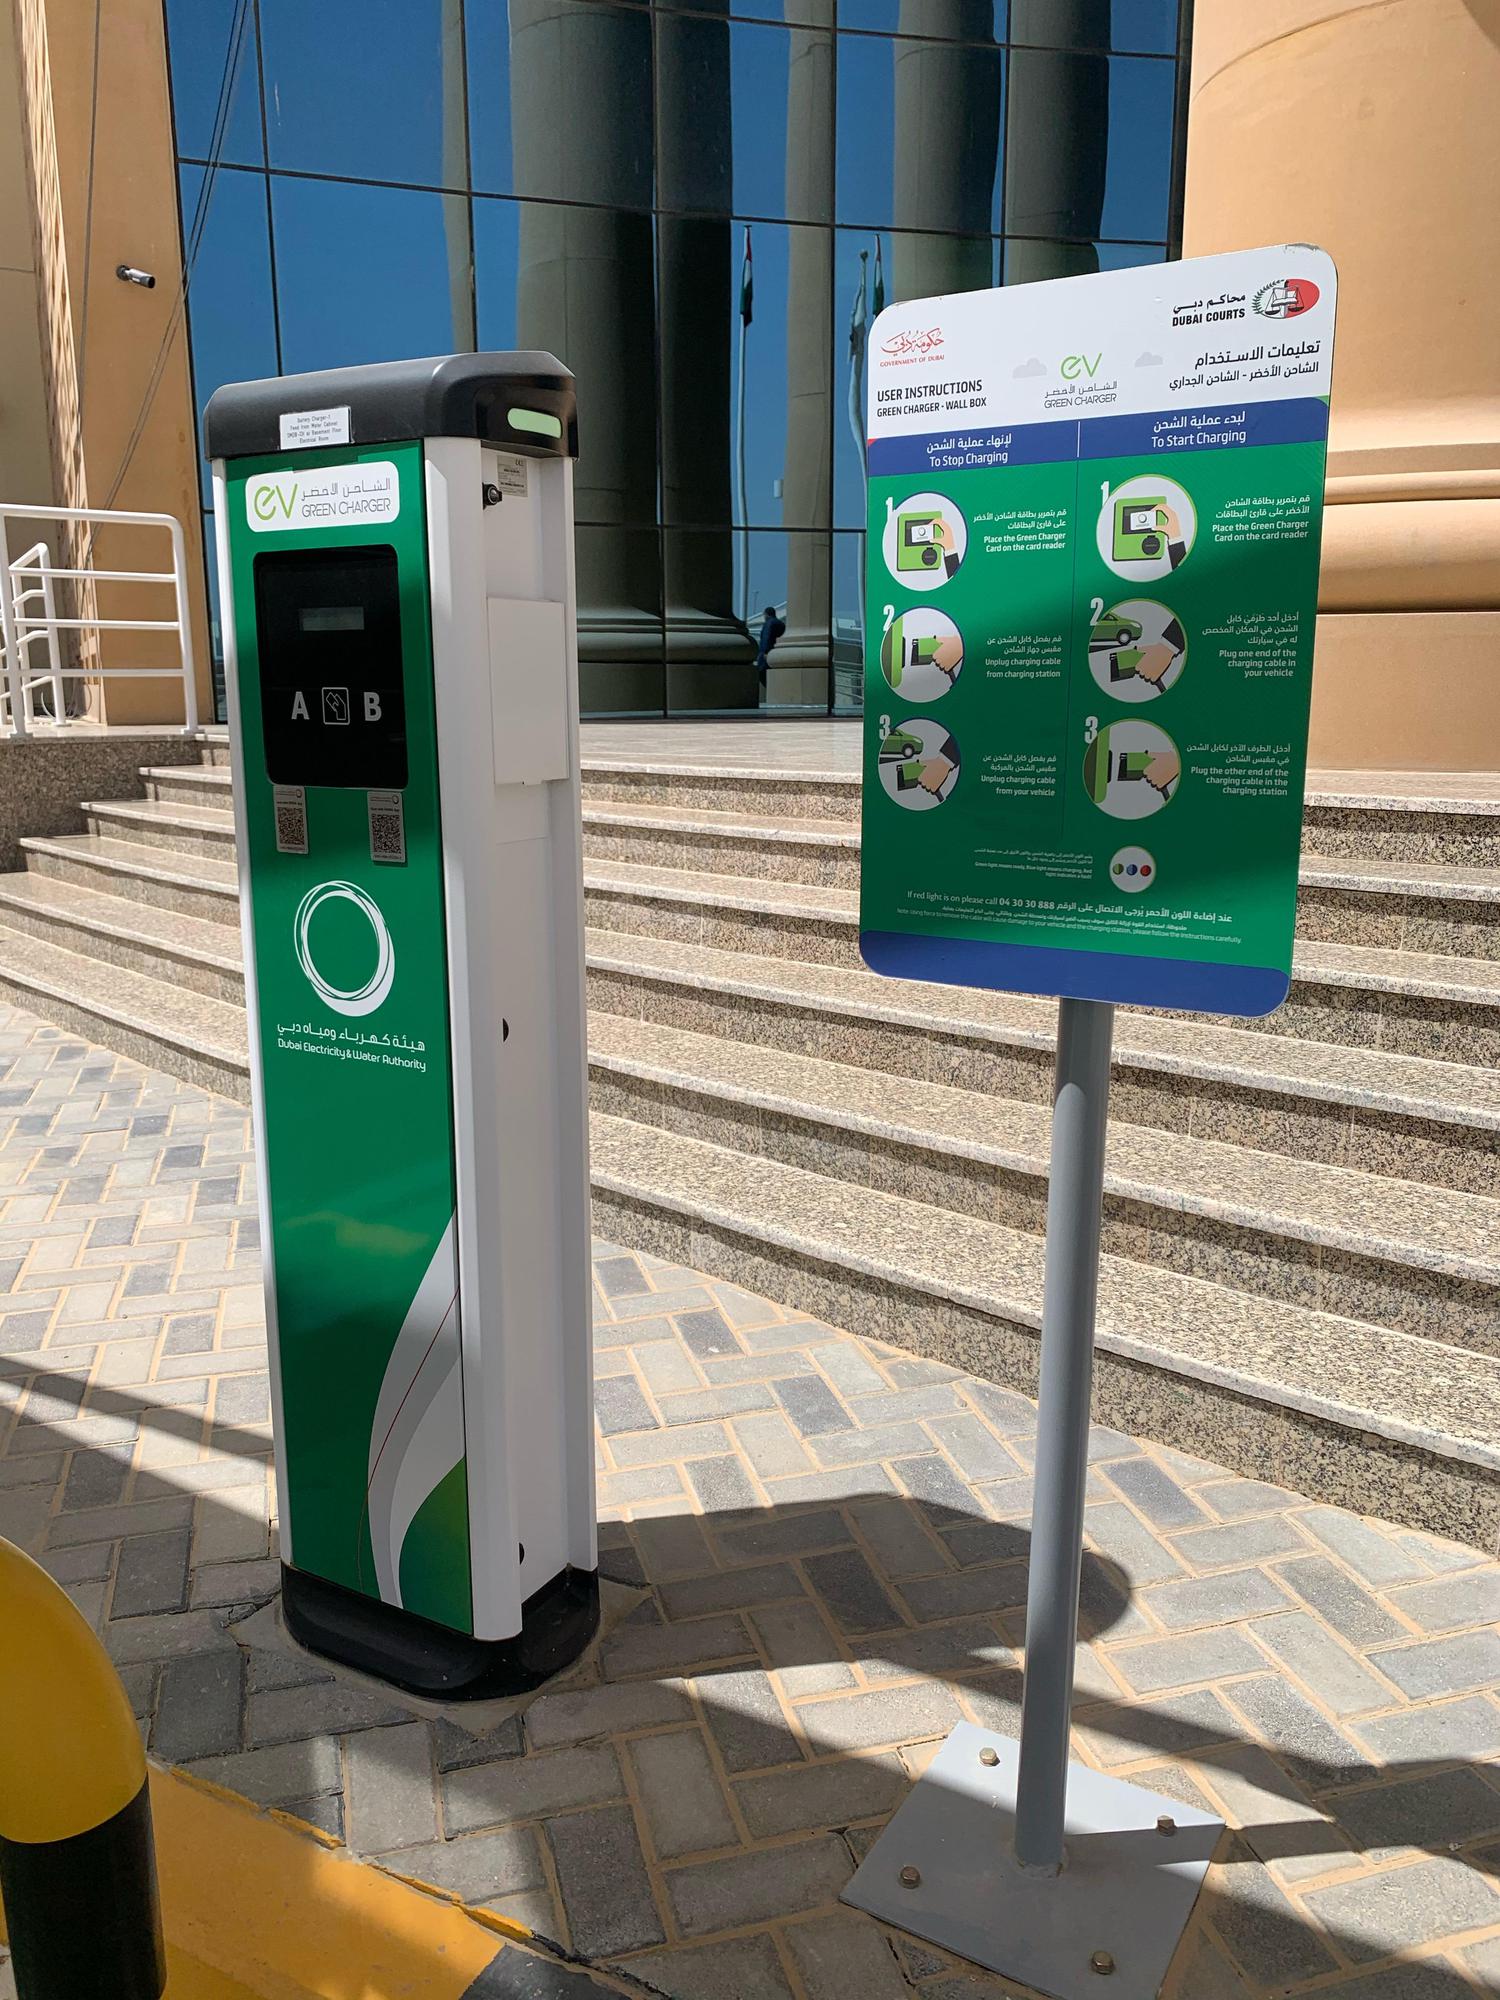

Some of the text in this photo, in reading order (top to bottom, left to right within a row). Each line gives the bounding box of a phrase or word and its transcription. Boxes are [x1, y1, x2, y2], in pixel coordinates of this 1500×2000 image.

[1173, 294, 1245, 314] محاكم دبي
[1173, 309, 1245, 327] DUBAI COURTS
[1268, 340, 1320, 359] تعليمات
[880, 358, 917, 367] GOVERNMENT
[1284, 362, 1319, 378] الشاحن
[1206, 370, 1239, 386] الشاحن
[1249, 364, 1281, 381] الأخضر
[1169, 374, 1203, 390] الجداري
[877, 380, 982, 402] USER INSTRUCTIONS
[877, 406, 901, 417] GREEN
[904, 402, 940, 414] CHARGER
[946, 400, 967, 410] WALL
[970, 397, 986, 407] BOX
[1044, 393, 1117, 408] GREEN CHARGER
[1154, 411, 1245, 433] لبدء عملية الشحن
[927, 433, 1011, 453] لإنهاء عملية الشحن
[1152, 431, 1246, 448] To Start Charging
[930, 451, 1008, 467] To Stop Charging
[1100, 481, 1110, 508] 1
[302, 498, 391, 517] GREEN CHARGER
[886, 497, 894, 520] 1
[1276, 521, 1309, 529] Charger
[1038, 533, 1066, 541] Charger
[1262, 532, 1279, 540] card
[883, 604, 895, 631] 2
[1090, 597, 1103, 625] 2
[1011, 658, 1040, 666] charging
[1228, 660, 1262, 668] charging
[1005, 670, 1034, 679] charging
[291, 692, 382, 721] A B
[879, 714, 891, 740] 3
[1084, 716, 1098, 744] 3
[1191, 767, 1208, 775] Plug
[1006, 776, 1035, 784] charging
[1206, 777, 1240, 785] charging
[1223, 786, 1287, 796] charging station
[927, 892, 942, 902] light
[1038, 901, 1054, 909] 888
[277, 1023, 425, 1052] هيئة كهرباء ومياه دبي
[278, 1038, 302, 1050] Dubai
[304, 1042, 346, 1060] Electricity
[352, 1050, 380, 1062] Water
[383, 1055, 426, 1072] Authority
